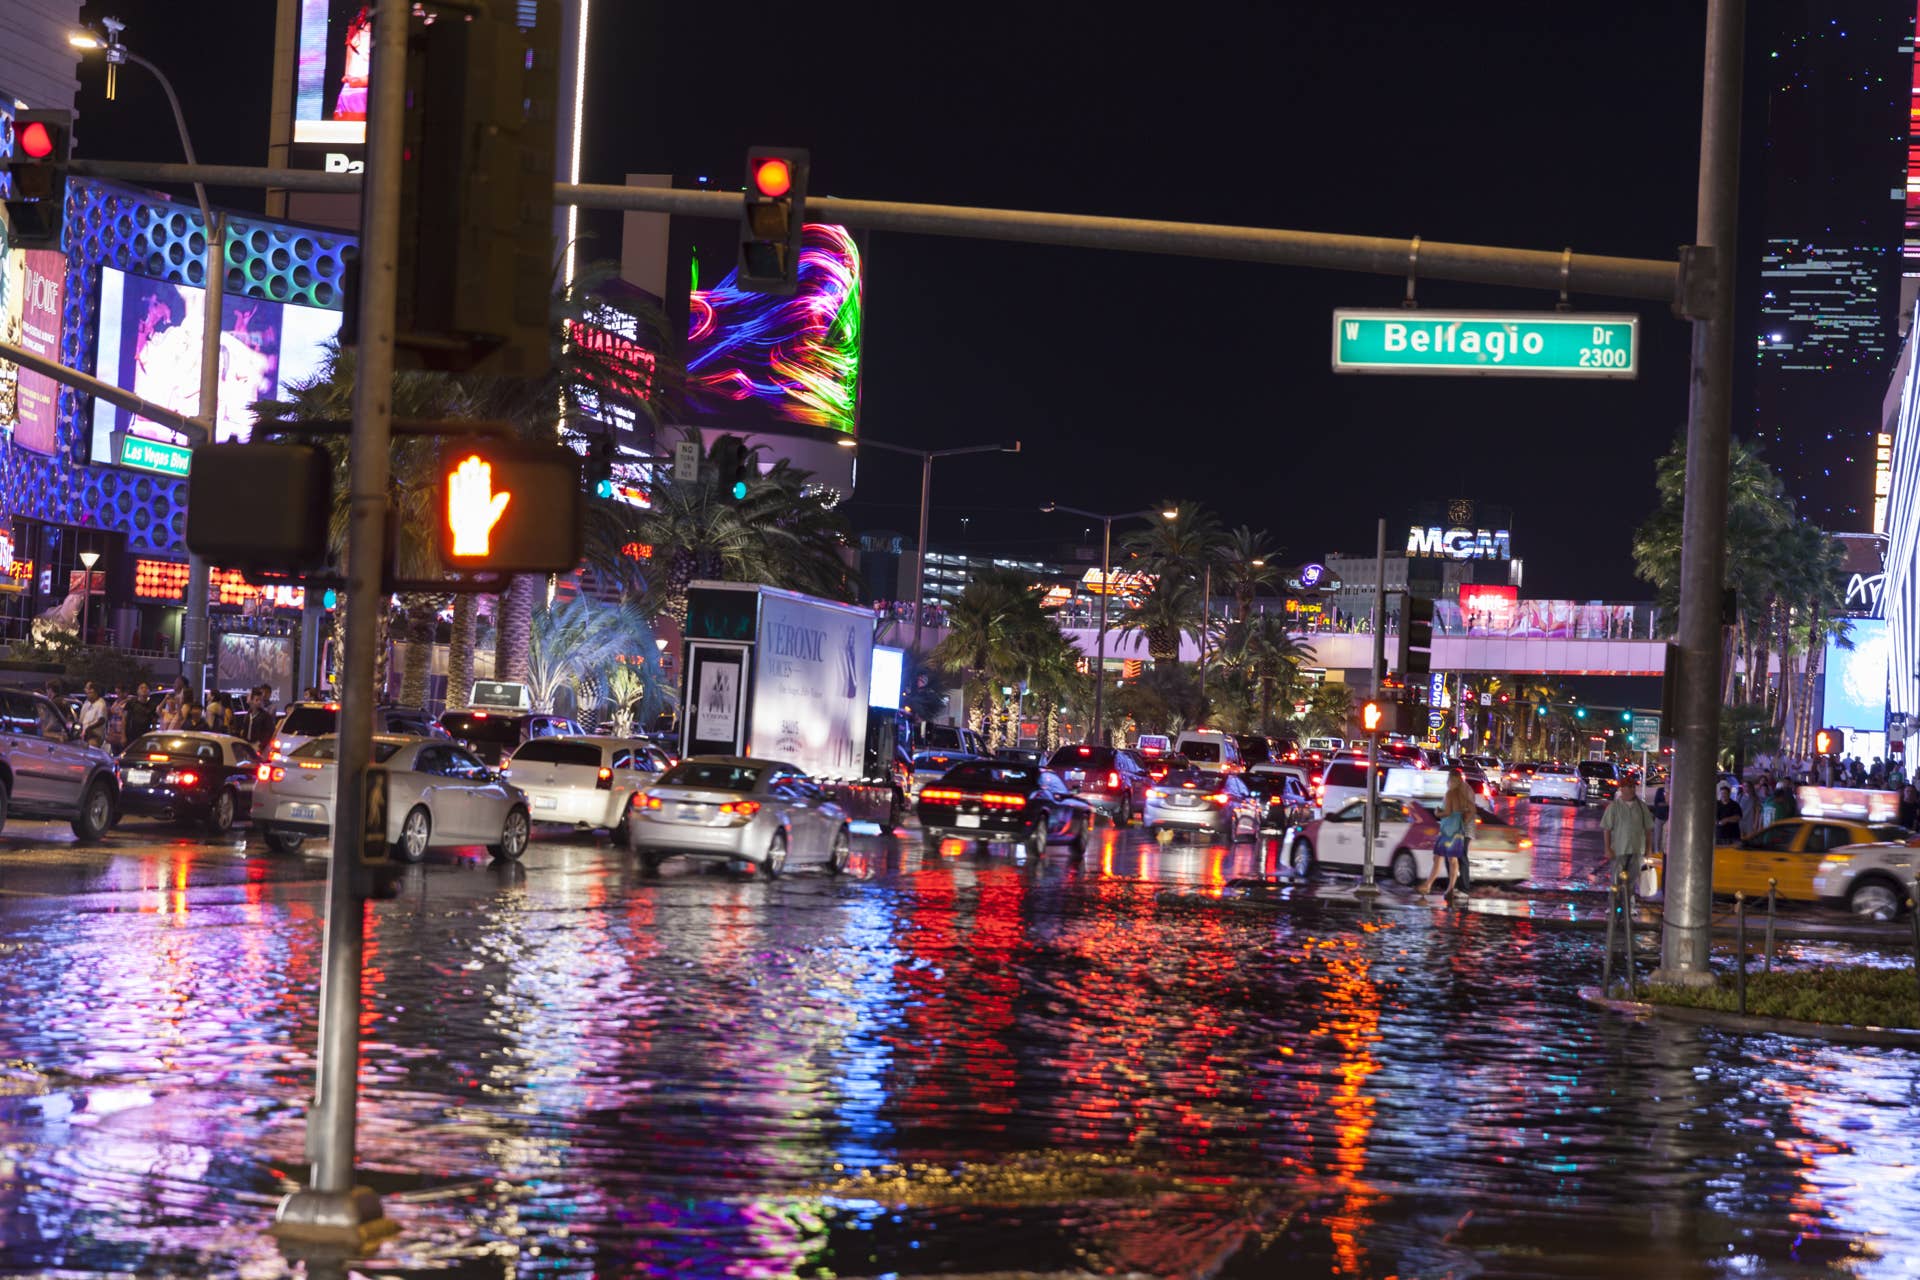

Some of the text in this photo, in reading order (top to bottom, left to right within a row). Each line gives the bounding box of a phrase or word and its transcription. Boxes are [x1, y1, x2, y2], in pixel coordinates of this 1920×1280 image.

[1345, 322, 1614, 362] W Bellagio Dr
[1579, 349, 1626, 367] 2300
[124, 441, 189, 470] Las Vegas Blvd
[681, 444, 694, 454] NO
[1405, 526, 1511, 560] MGM
